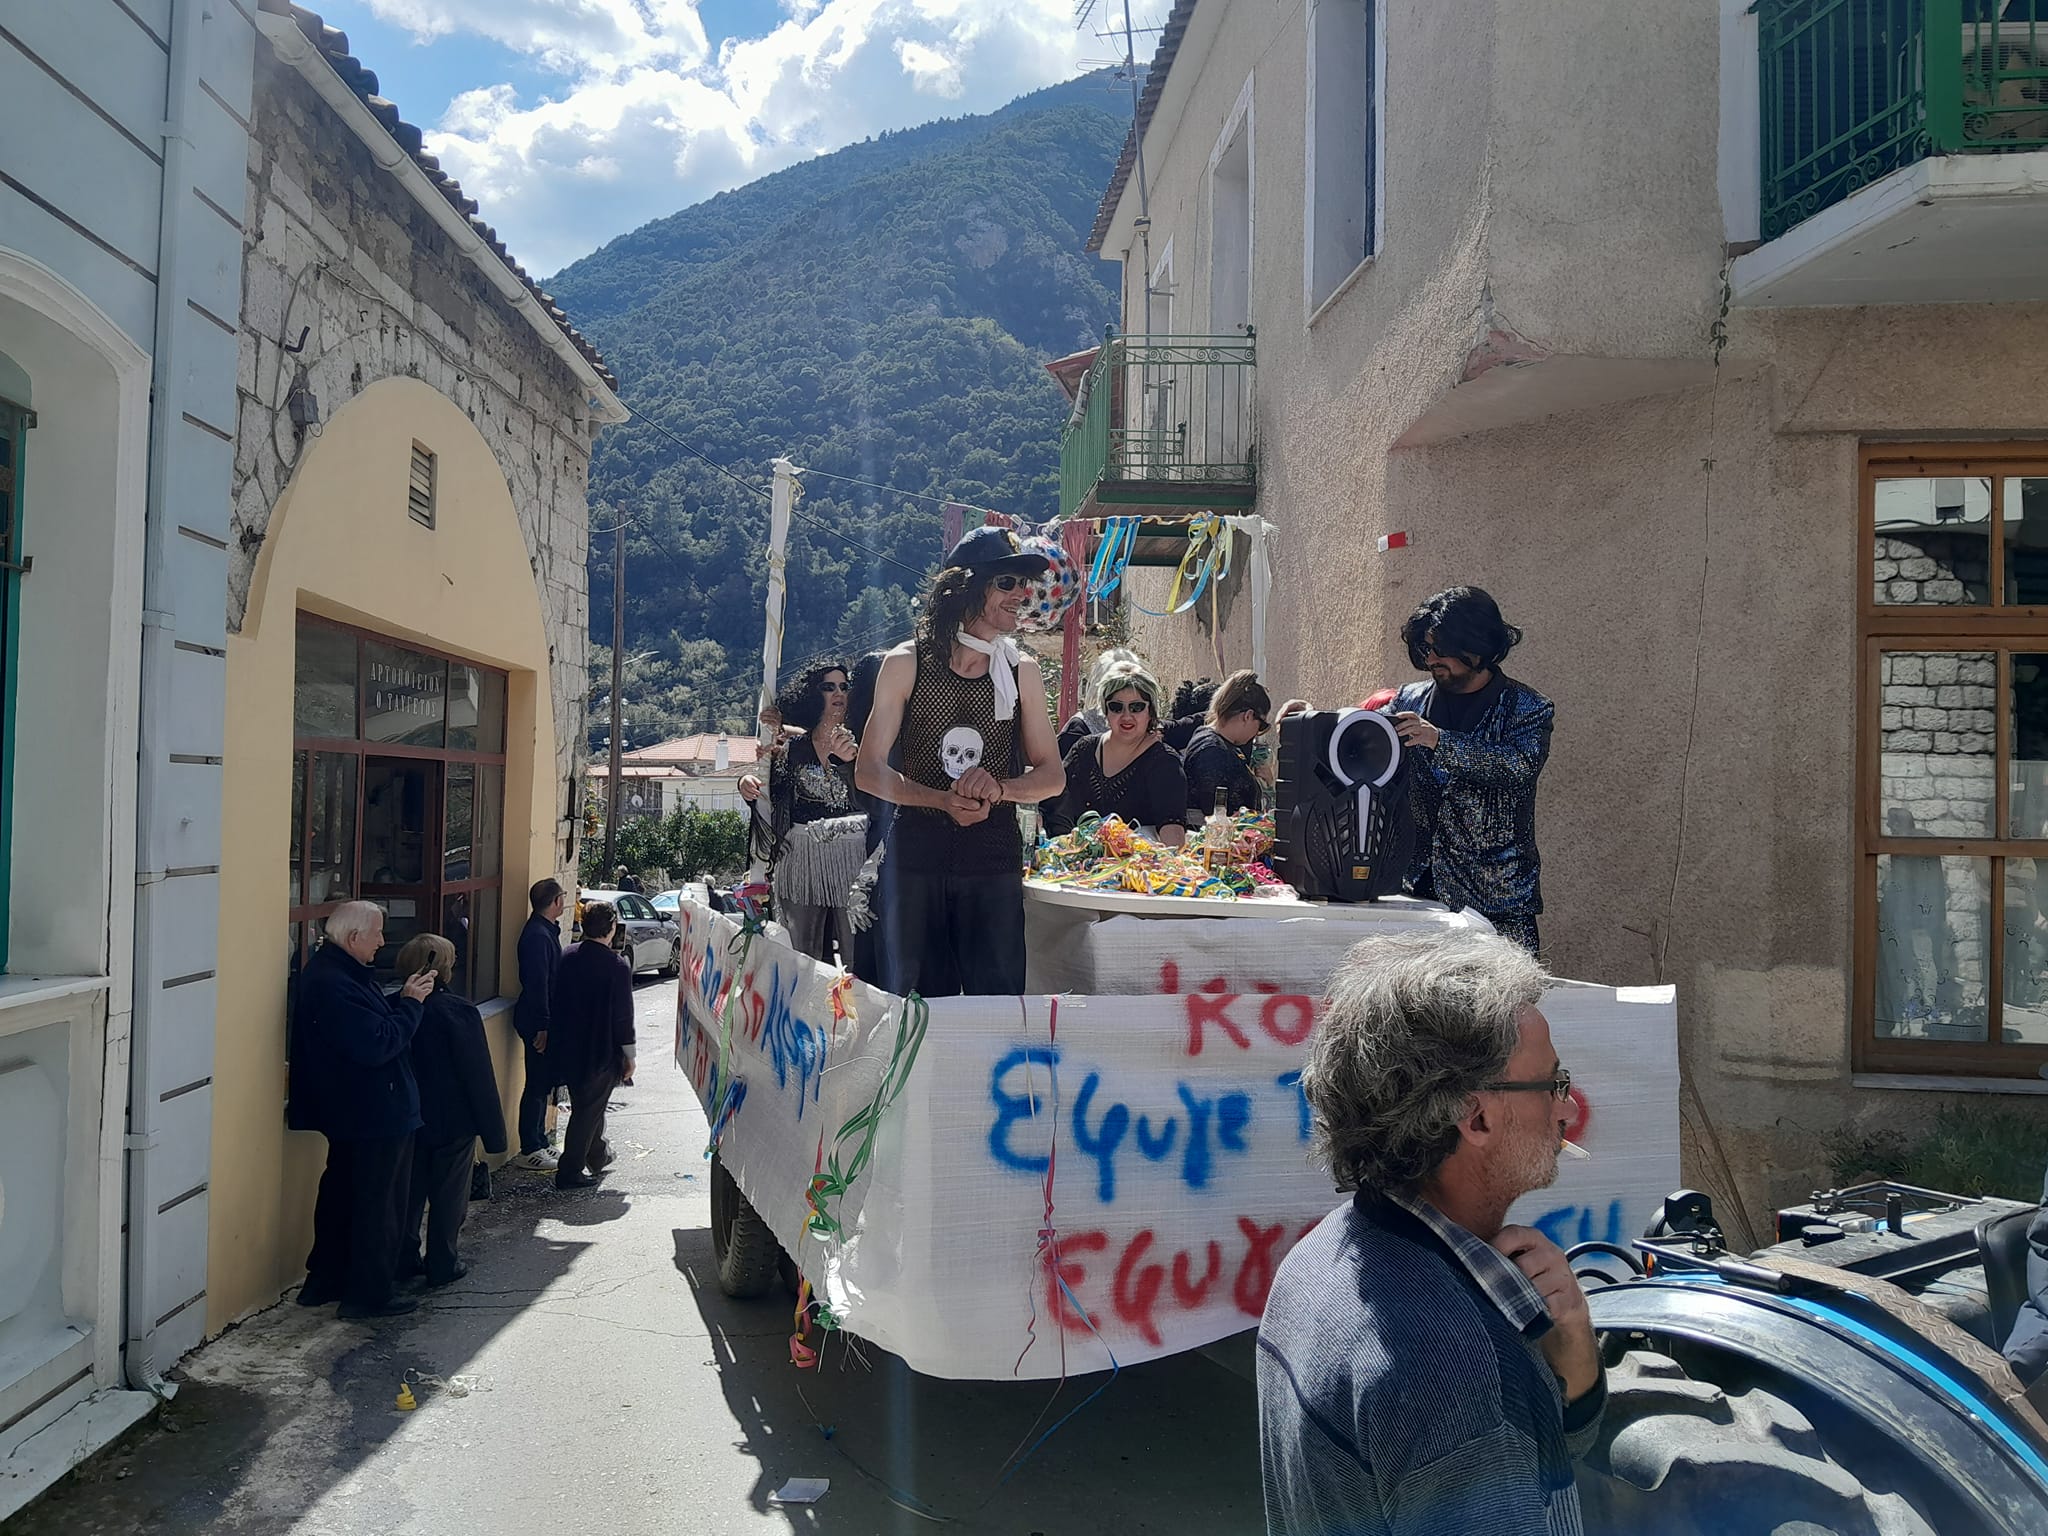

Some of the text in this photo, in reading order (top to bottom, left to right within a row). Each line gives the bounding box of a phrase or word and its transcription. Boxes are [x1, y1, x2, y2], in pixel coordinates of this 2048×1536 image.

[370, 662, 440, 693] ΑΡΤΟΠΟΙΕΙΟΝ
[376, 690, 437, 718] Ο ΤΑΥΓΕΤΟΣ
[1042, 1214, 1325, 1347] Εφυγ
